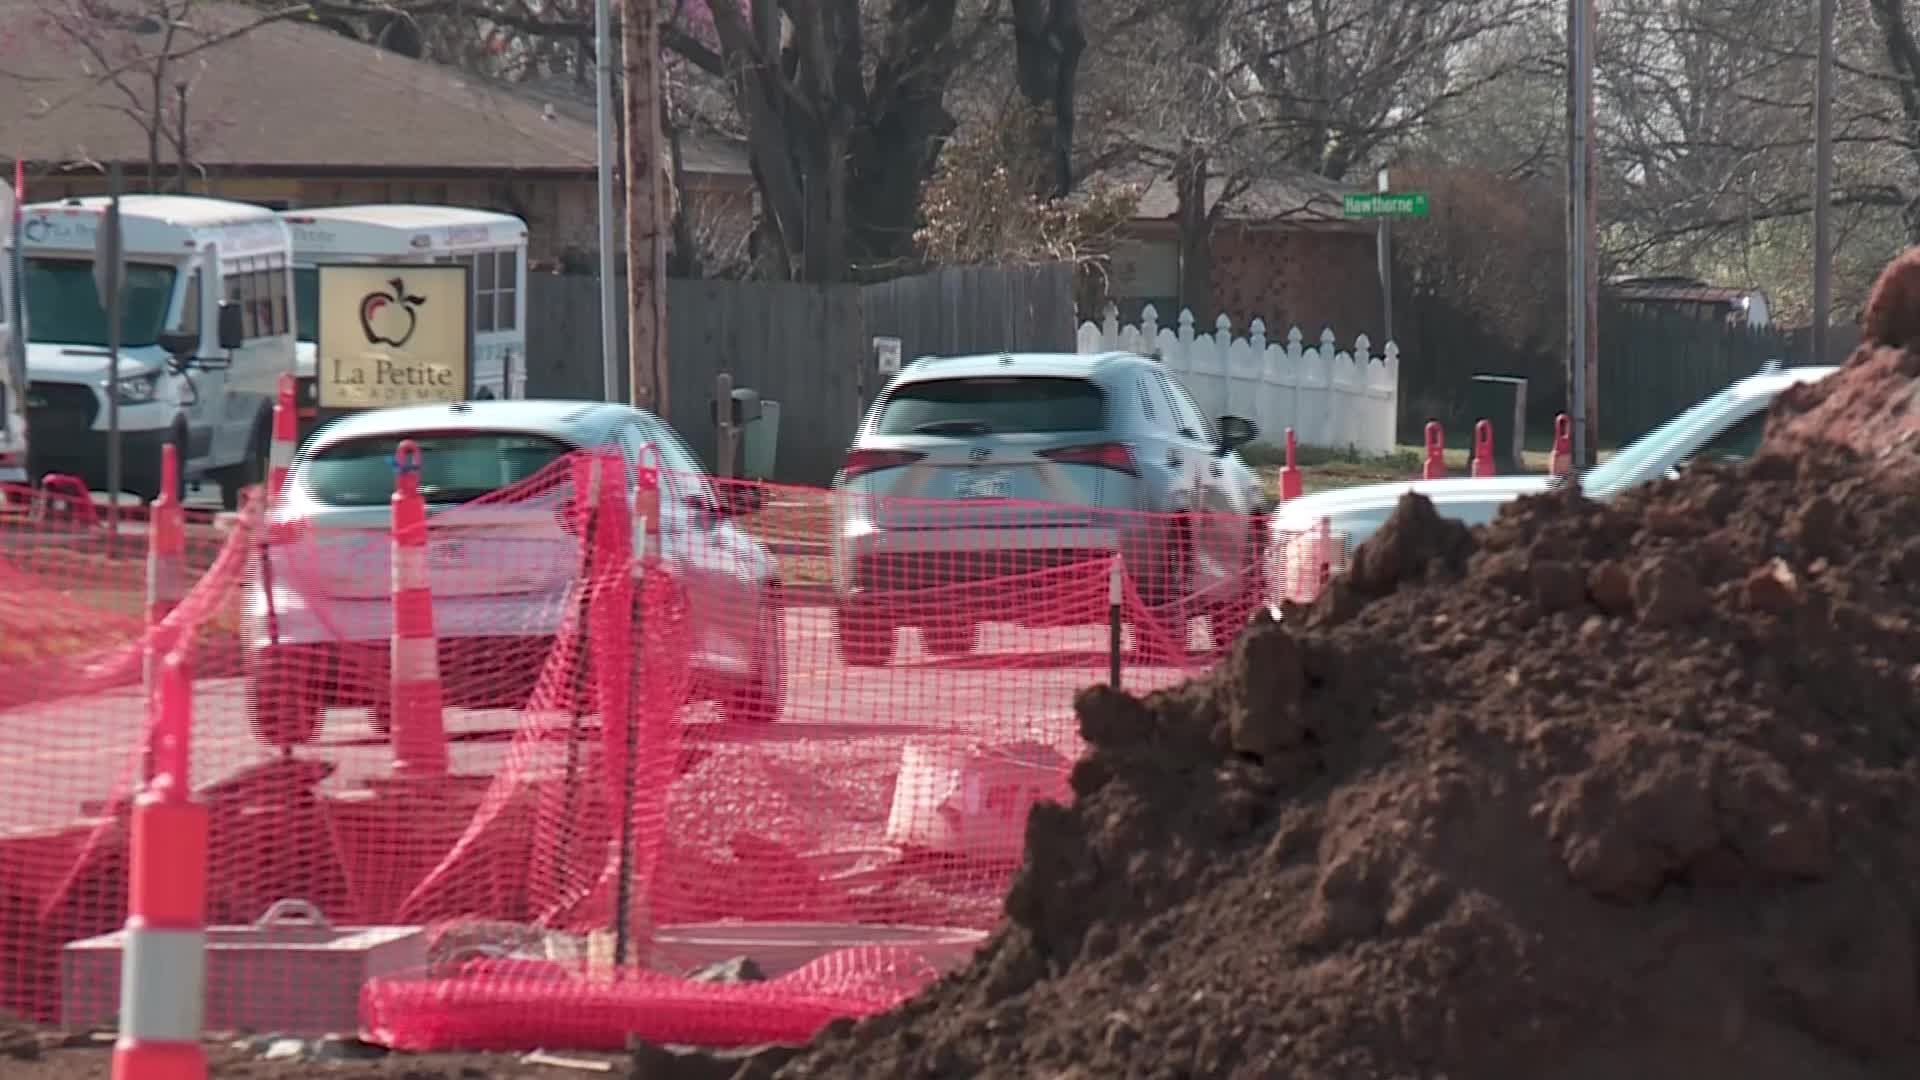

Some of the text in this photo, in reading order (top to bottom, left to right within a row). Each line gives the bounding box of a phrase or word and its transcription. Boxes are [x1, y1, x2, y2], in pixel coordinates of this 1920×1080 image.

[1344, 195, 1415, 213] Hawthorne
[332, 359, 453, 386] La Petite
